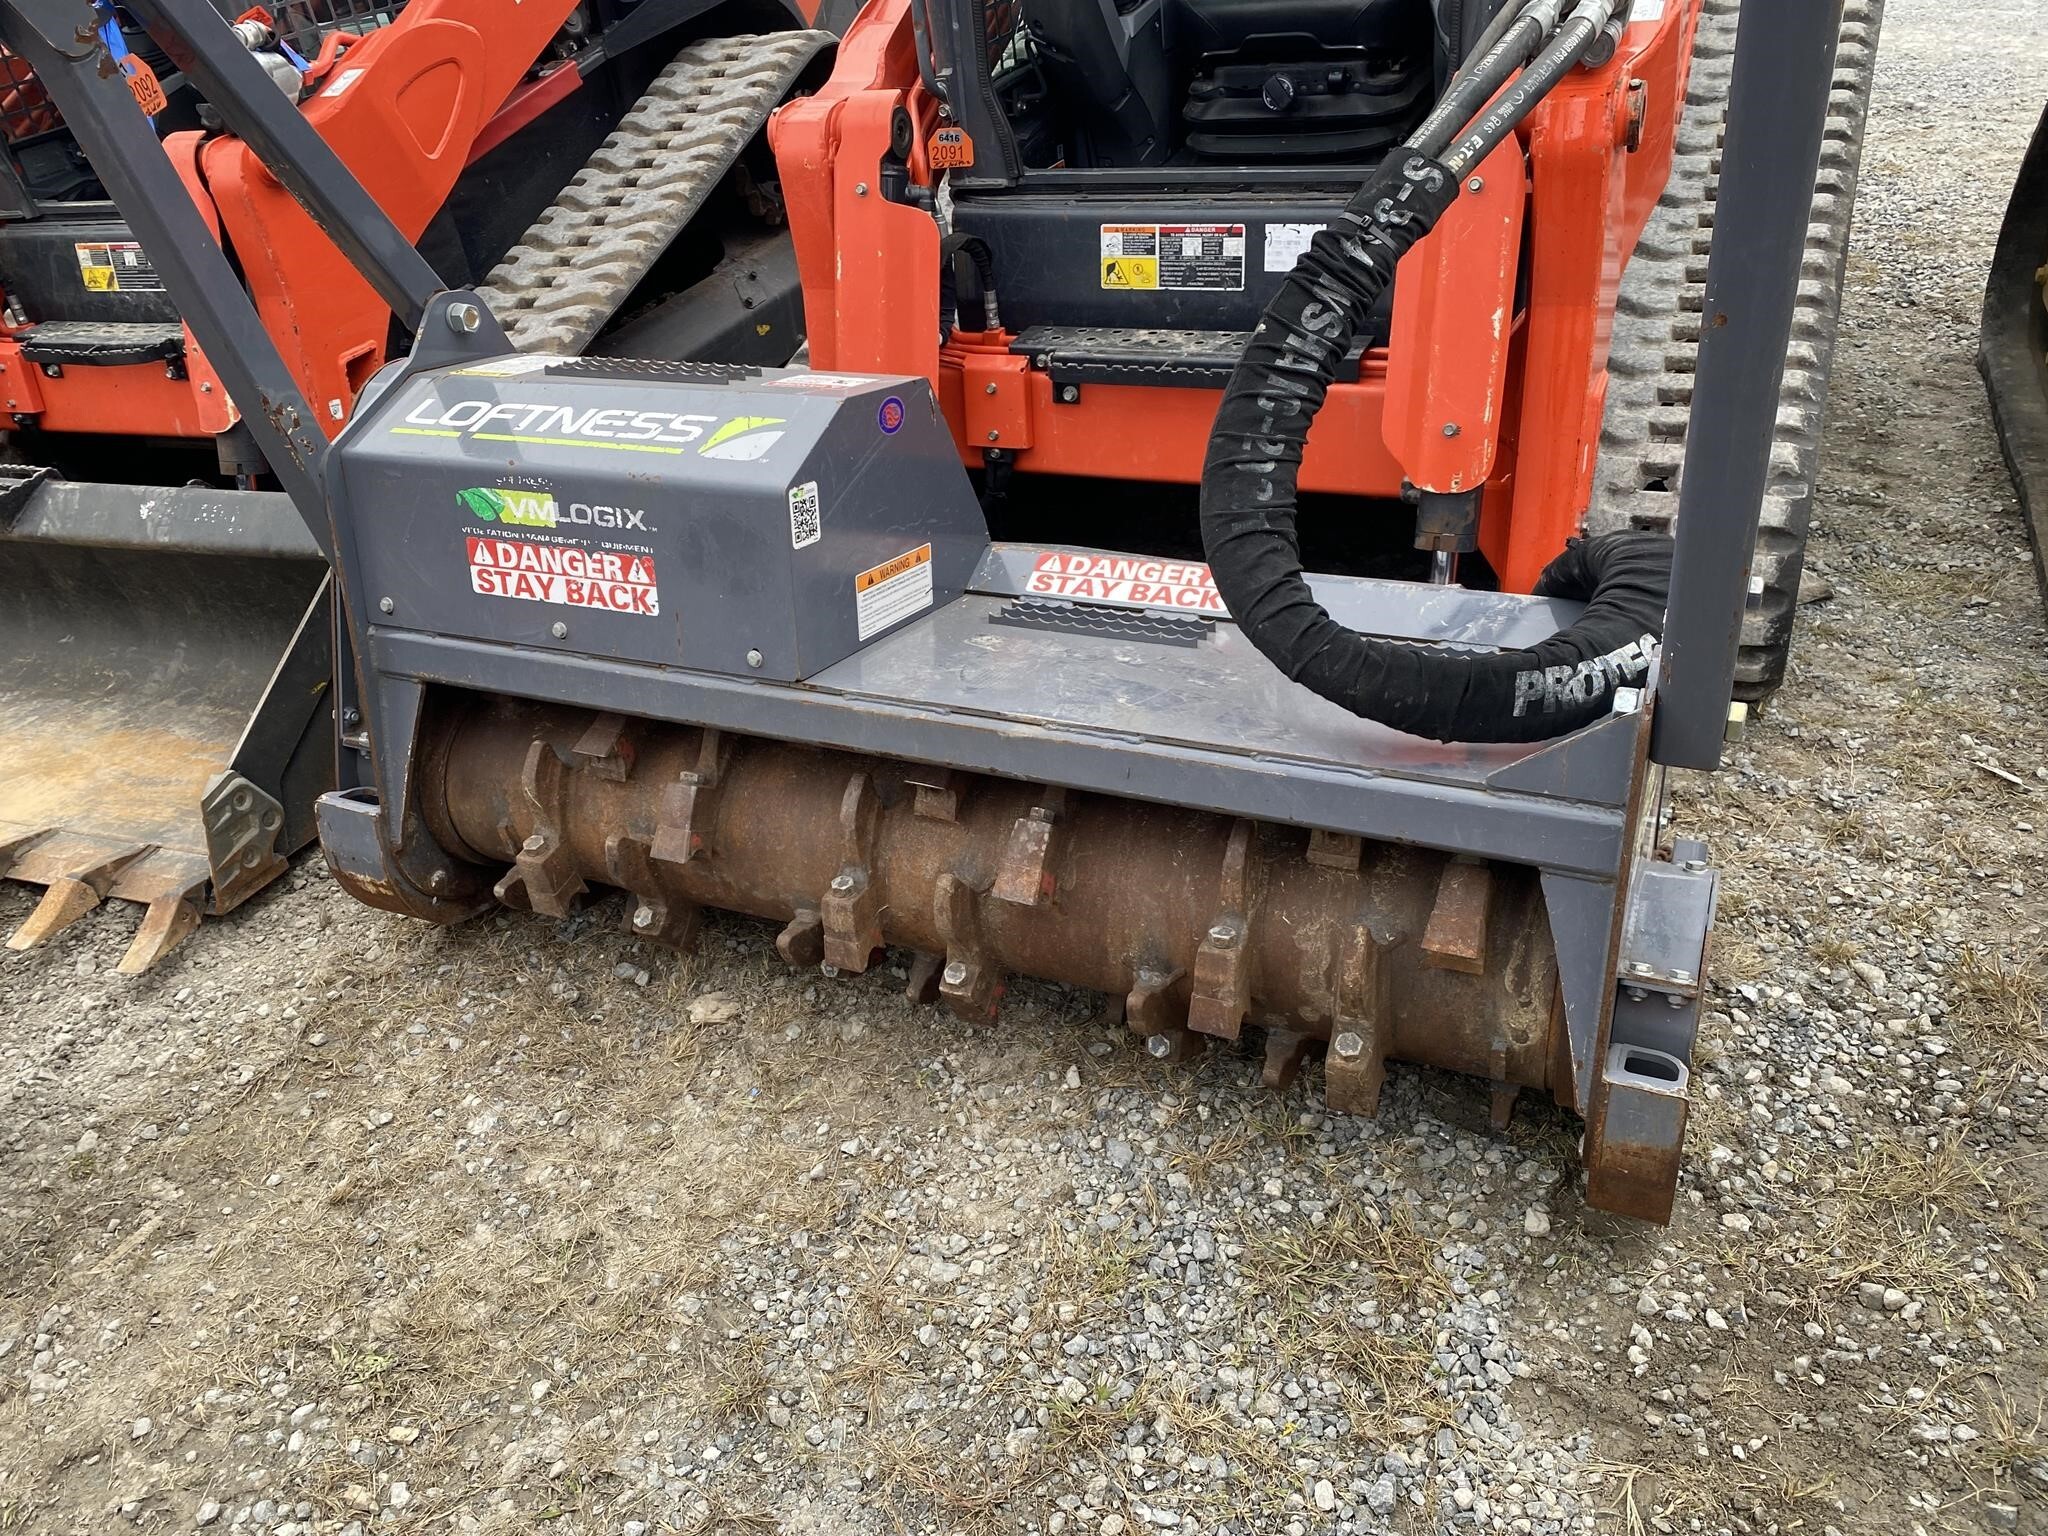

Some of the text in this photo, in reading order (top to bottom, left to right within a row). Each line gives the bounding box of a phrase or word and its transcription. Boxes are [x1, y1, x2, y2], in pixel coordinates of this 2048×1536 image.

[932, 145, 963, 160] 2091
[405, 398, 718, 443] LOFTNESS
[496, 542, 624, 581] DANGER
[880, 557, 910, 580] WARNING
[1066, 556, 1204, 586] DANGER
[477, 569, 656, 613] STAY BACK
[1032, 574, 1221, 610] STAY BACK
